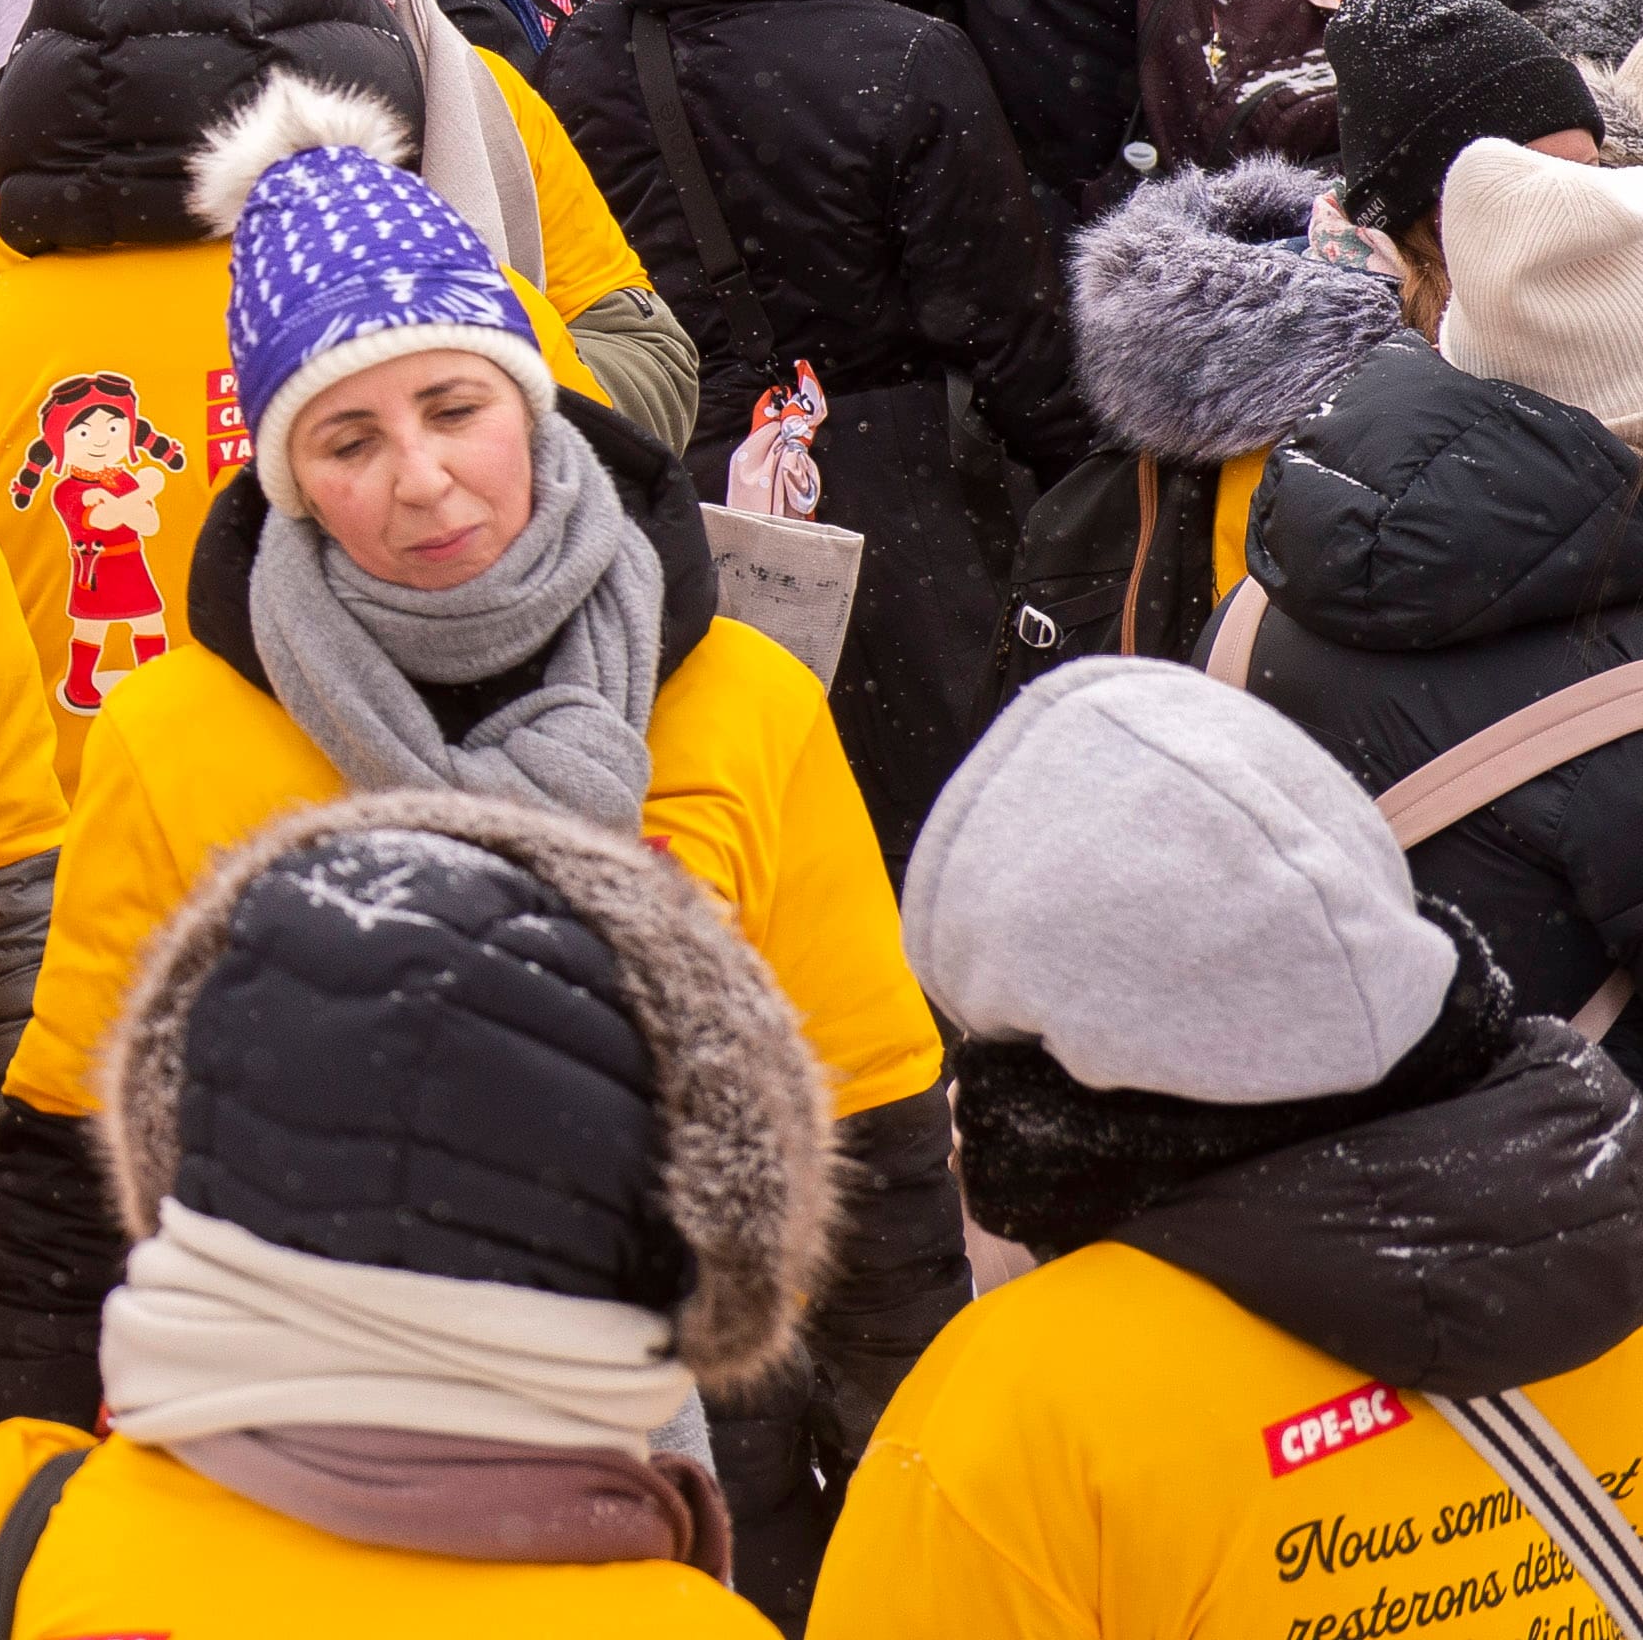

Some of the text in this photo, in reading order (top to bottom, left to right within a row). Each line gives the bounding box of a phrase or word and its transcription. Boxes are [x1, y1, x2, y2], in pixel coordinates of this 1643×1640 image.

[220, 438, 252, 461] Y A
[1281, 1380, 1400, 1464] CPE-BC
[1275, 1514, 1422, 1583] Nous
